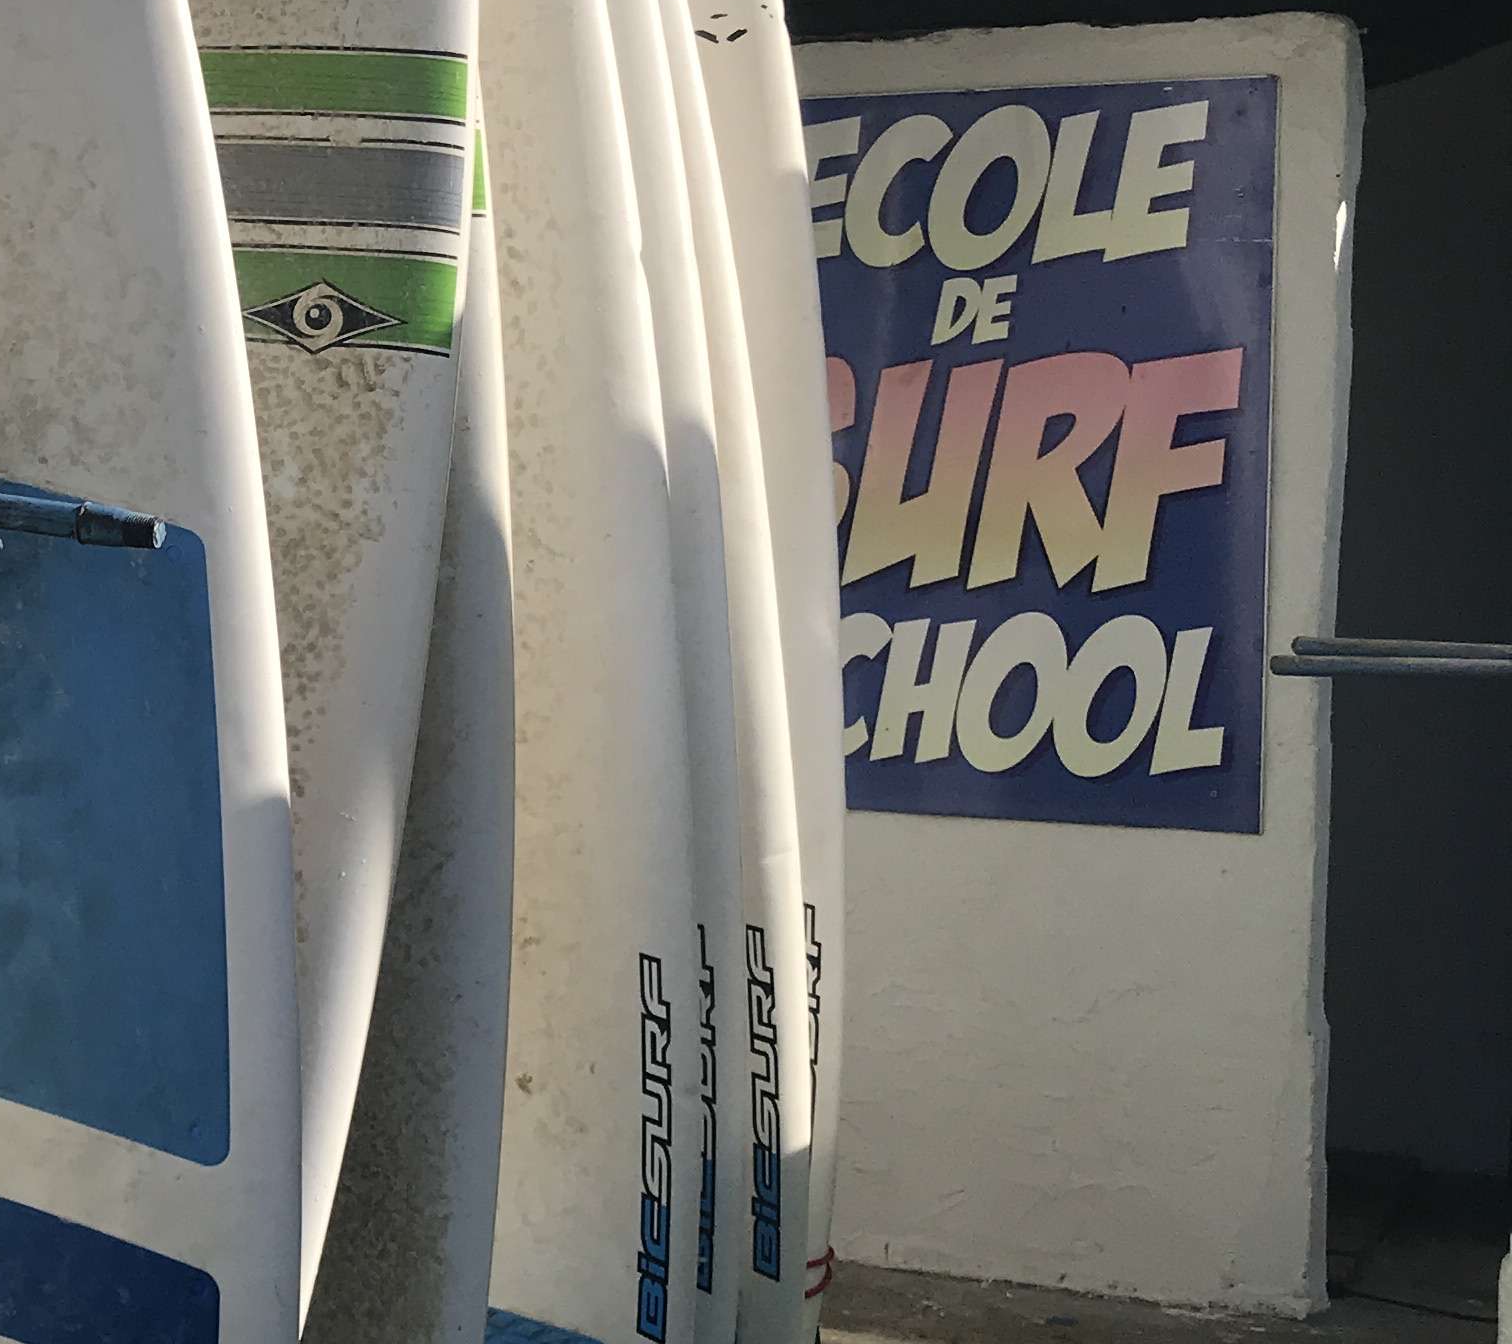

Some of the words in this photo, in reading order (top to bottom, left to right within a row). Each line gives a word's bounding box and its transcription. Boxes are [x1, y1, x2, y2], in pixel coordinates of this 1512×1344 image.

[811, 99, 1210, 271] ECOLE
[931, 273, 1018, 346] DE
[840, 611, 1224, 778] CHOOL
